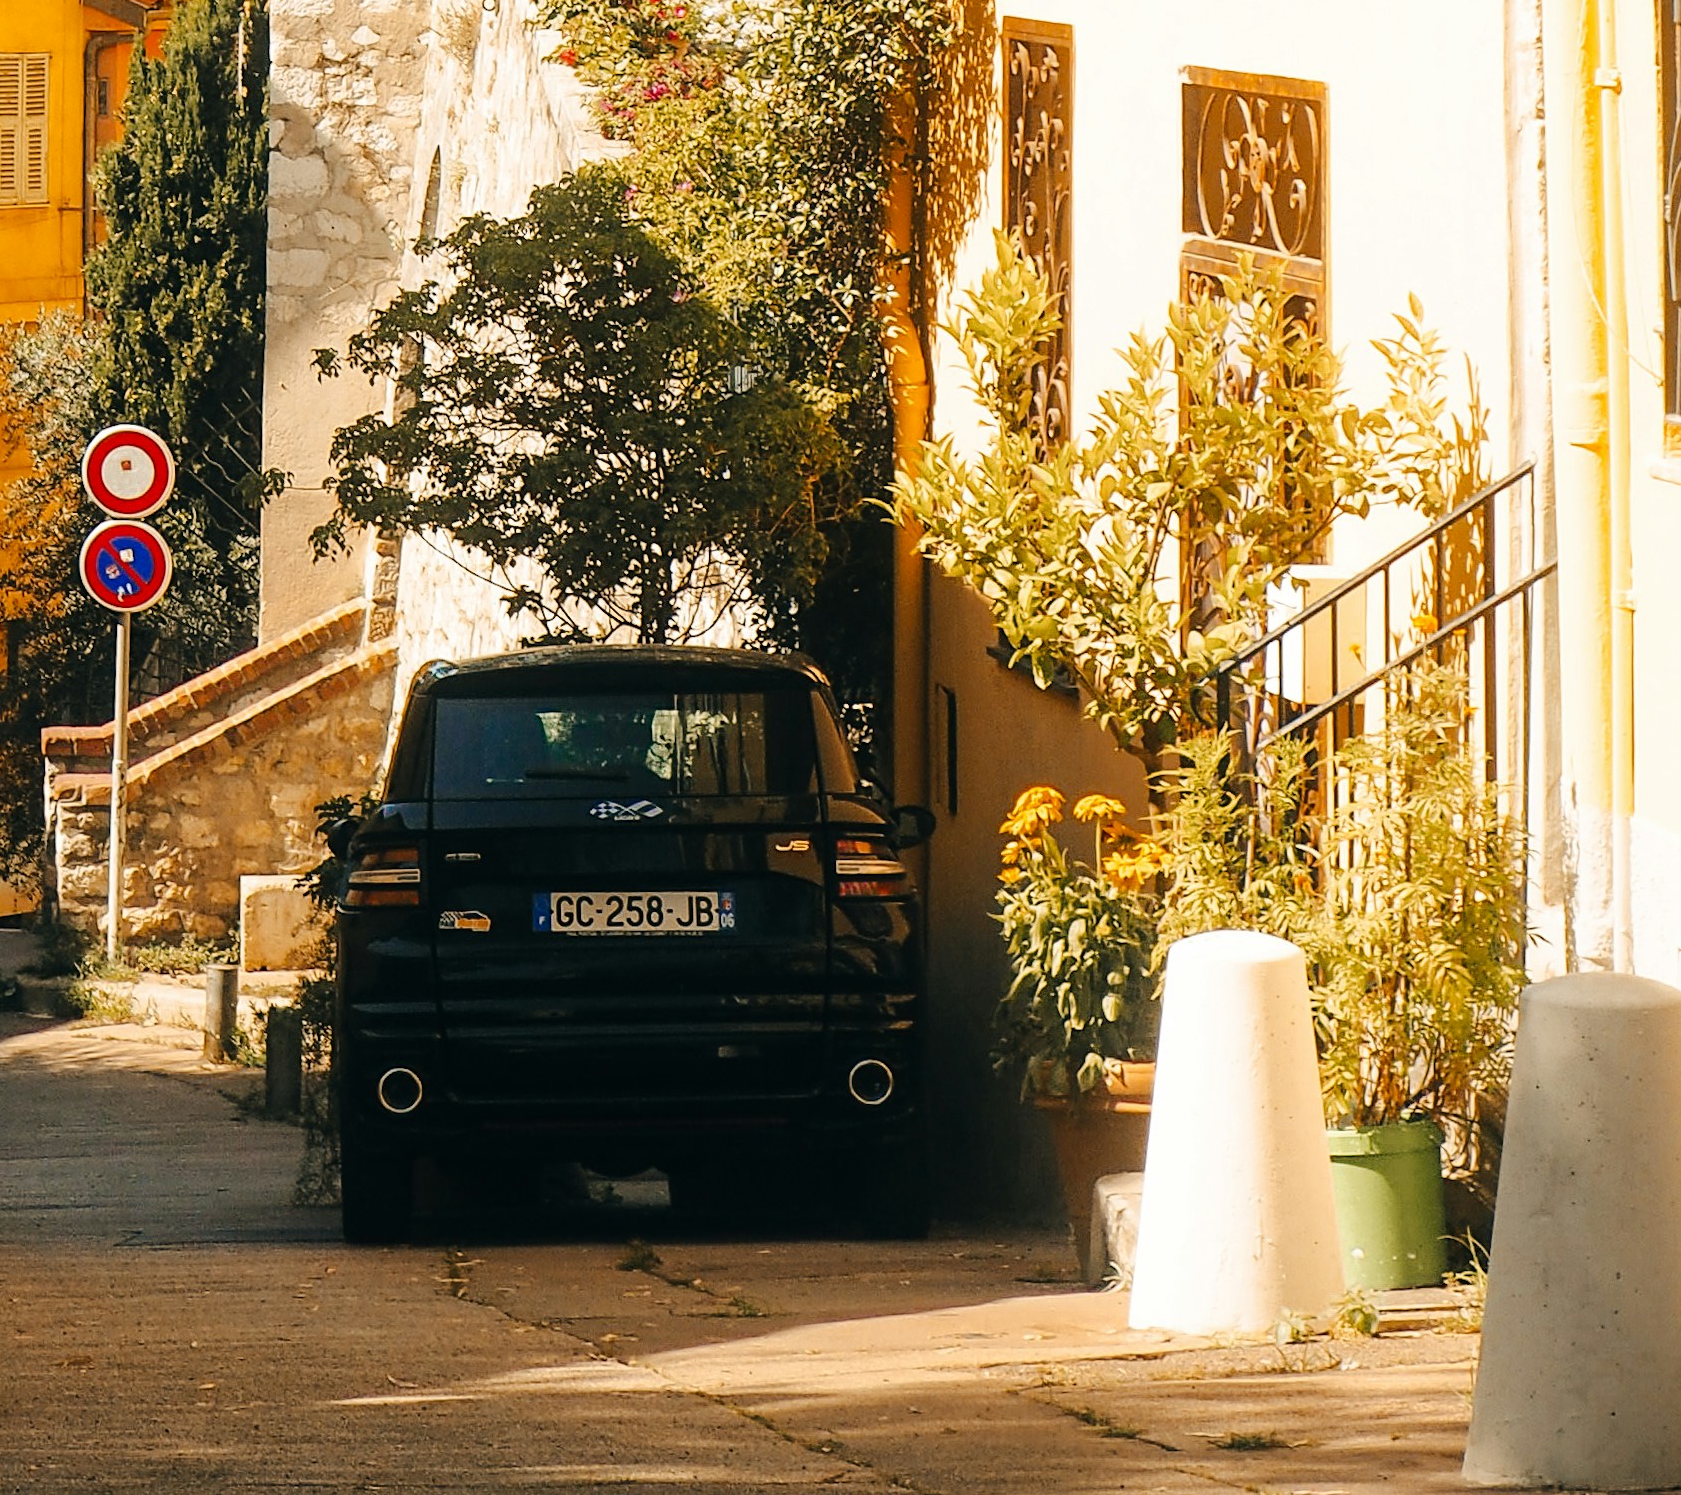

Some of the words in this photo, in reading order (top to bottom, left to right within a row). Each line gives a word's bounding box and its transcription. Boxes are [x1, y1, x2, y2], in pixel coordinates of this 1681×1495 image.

[555, 895, 714, 927] GC-258-JB
[538, 915, 546, 926] F
[720, 913, 736, 928] 06
